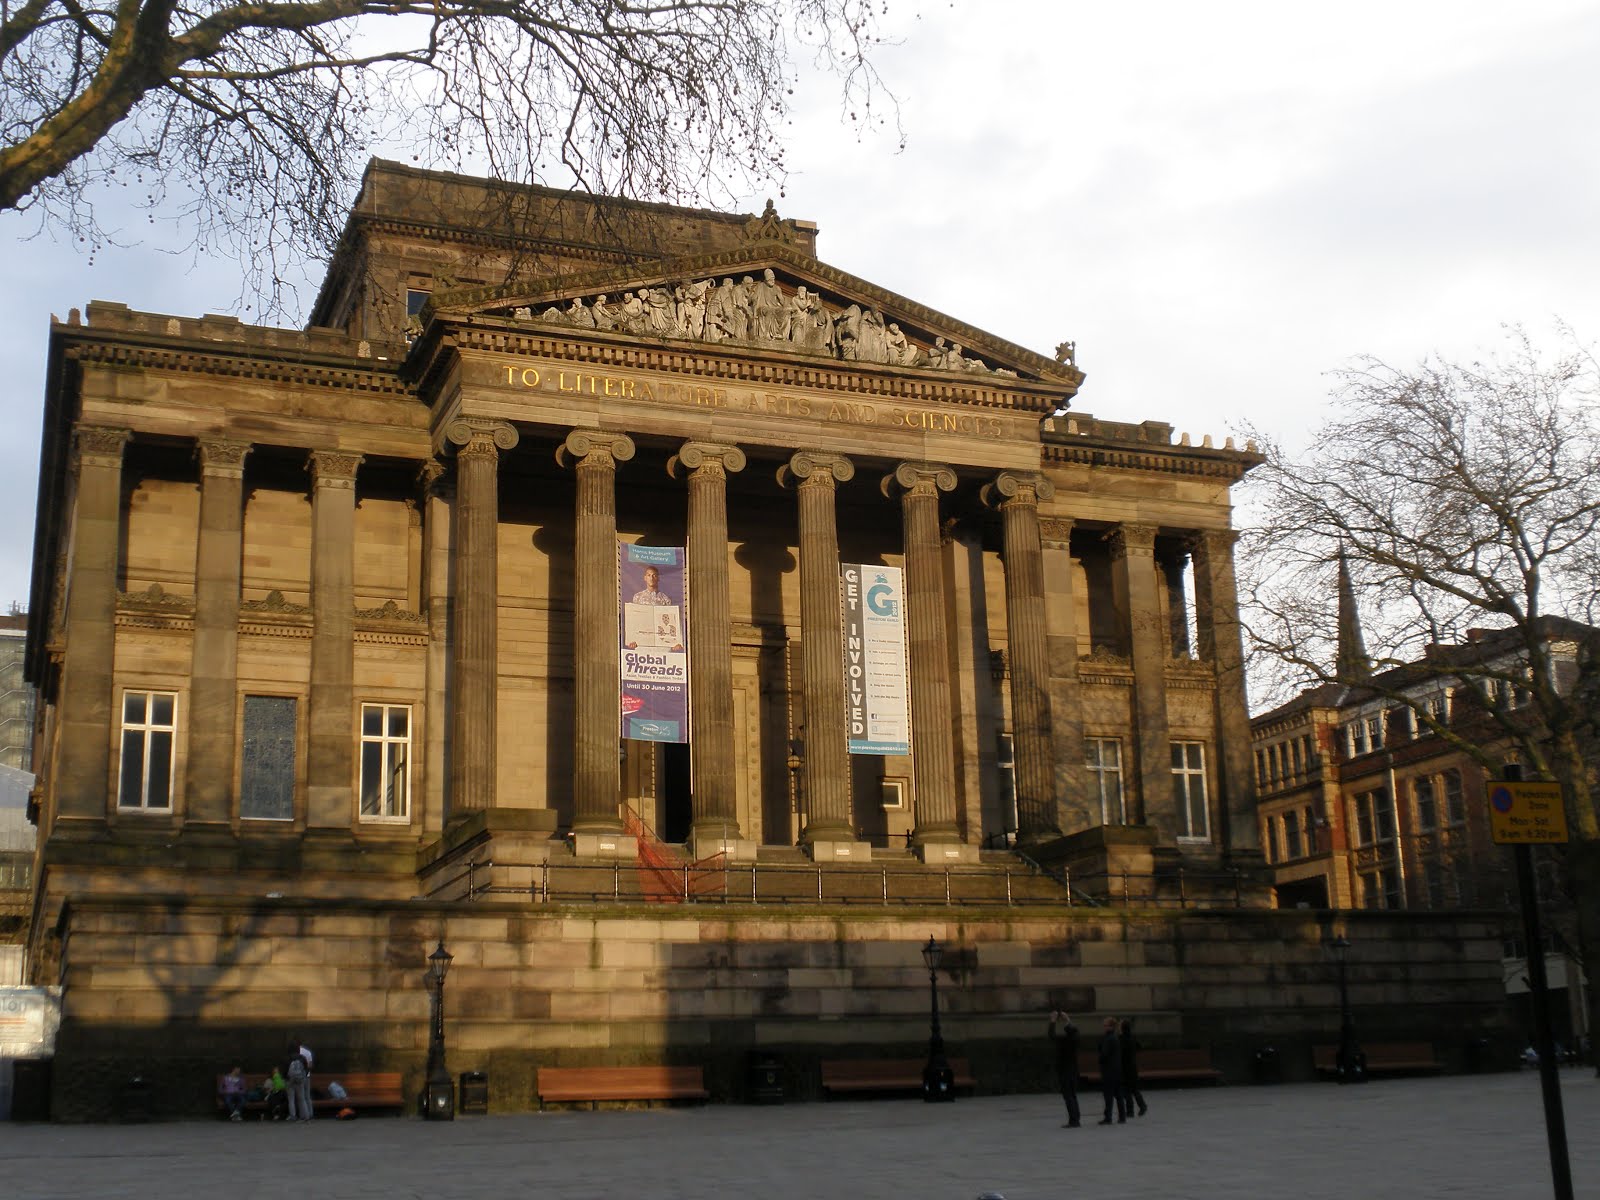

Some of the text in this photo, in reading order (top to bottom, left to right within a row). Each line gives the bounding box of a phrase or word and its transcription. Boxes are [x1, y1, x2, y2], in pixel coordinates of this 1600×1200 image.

[503, 365, 1002, 437] TO LITERATURE ARTS AND SCIENCES
[625, 653, 667, 665] Global
[626, 662, 683, 676] Threads
